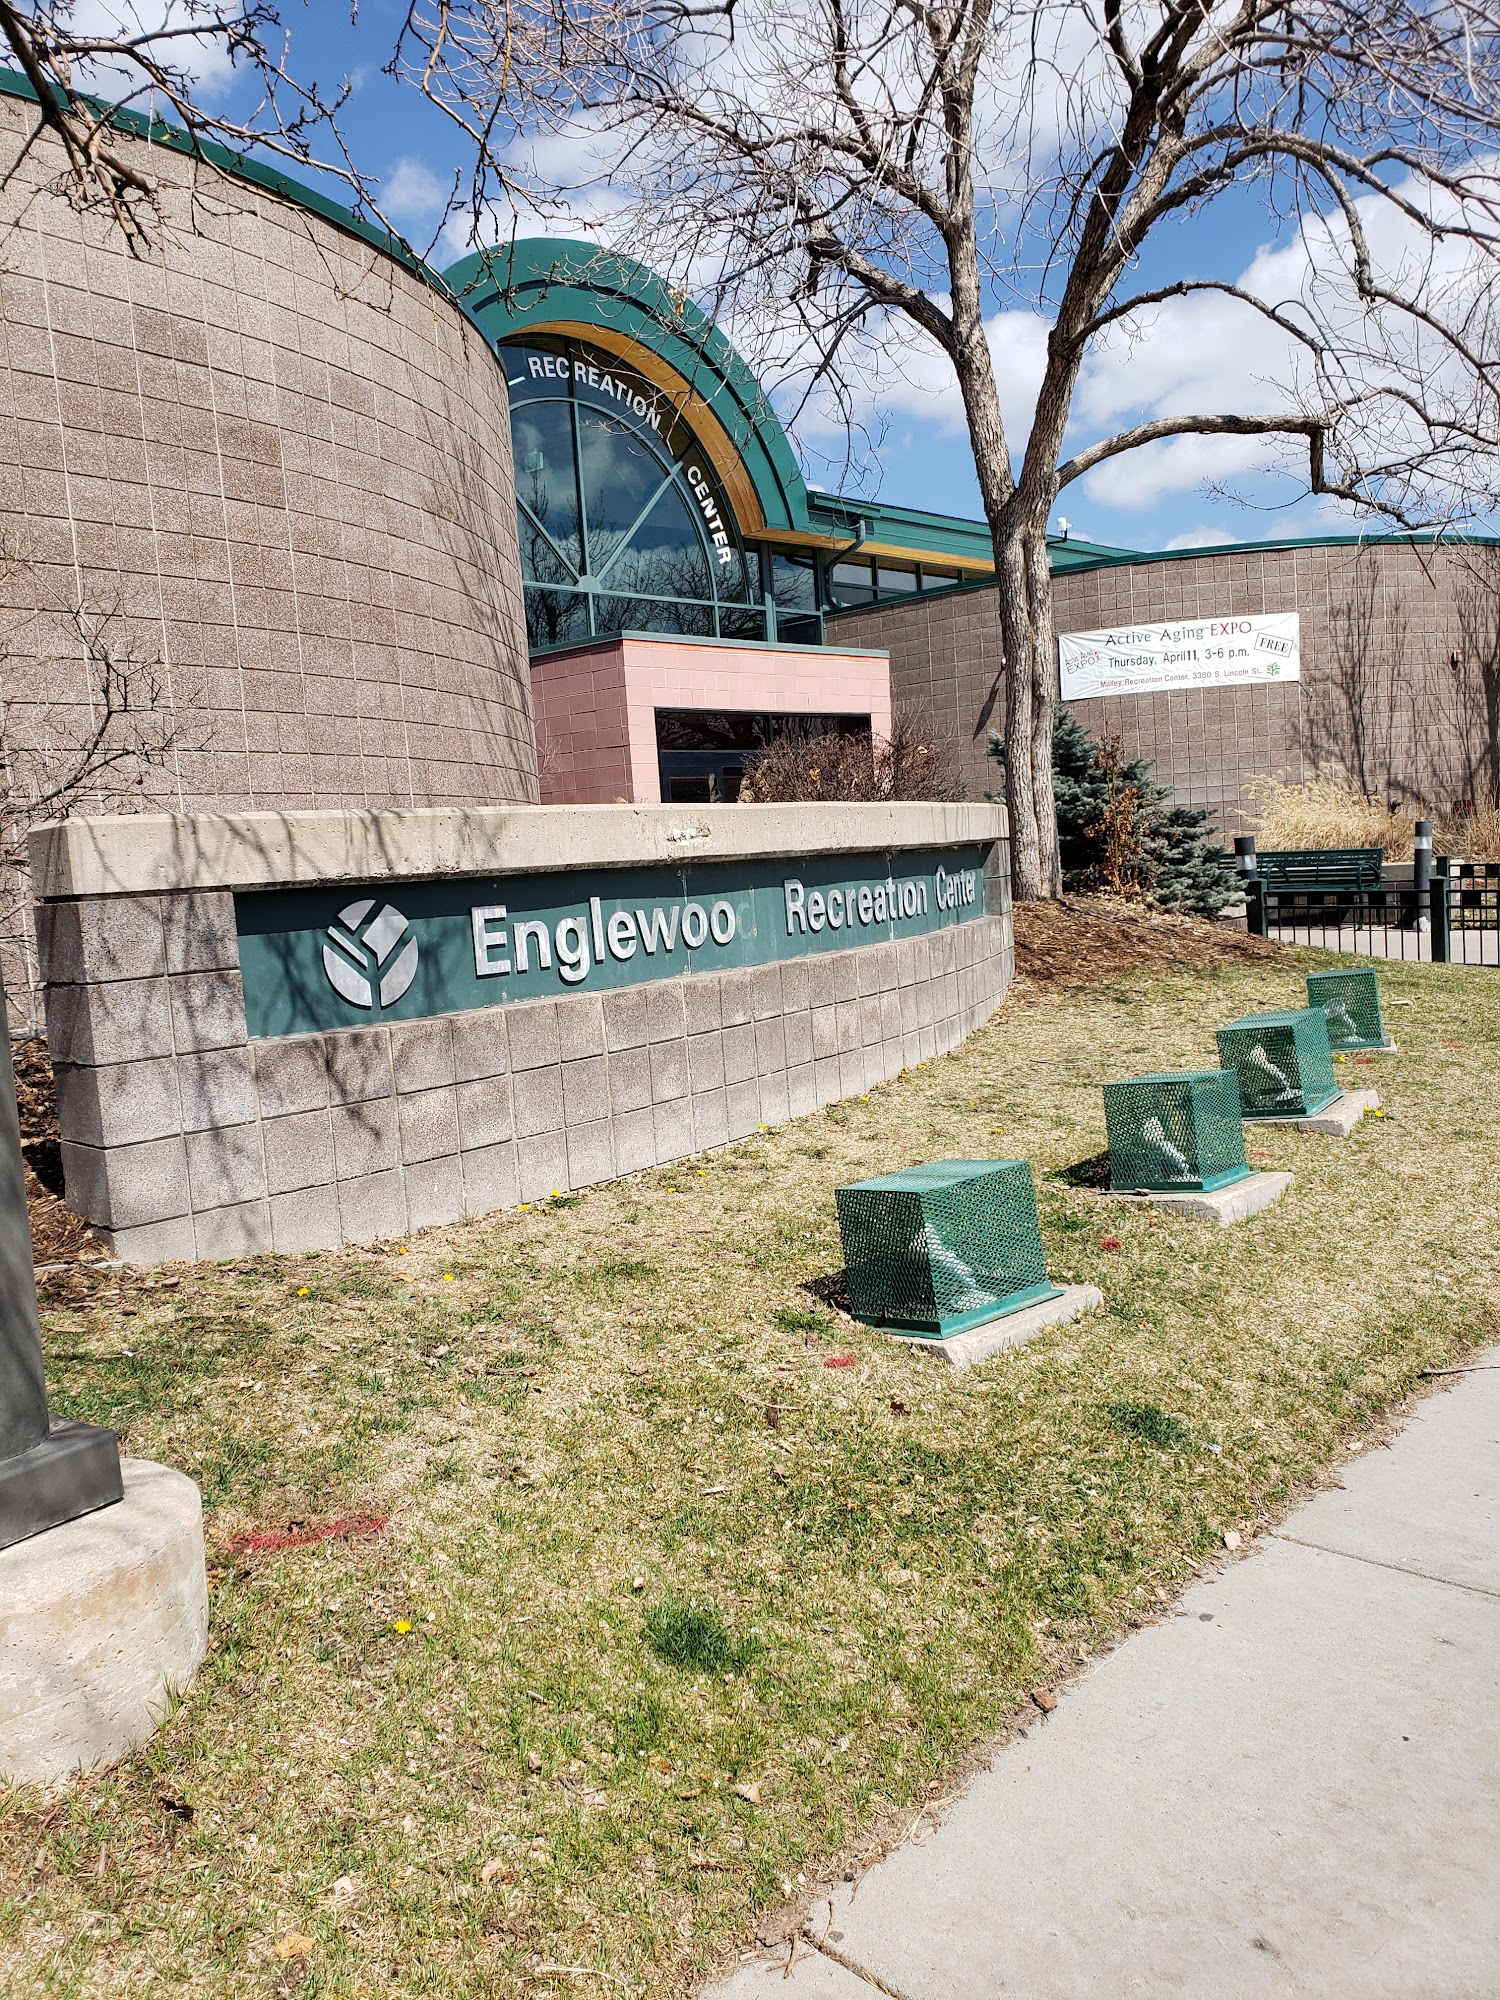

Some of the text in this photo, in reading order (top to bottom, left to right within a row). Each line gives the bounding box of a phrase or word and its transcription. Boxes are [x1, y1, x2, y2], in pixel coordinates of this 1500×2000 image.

[527, 356, 732, 565] RECREATION CENTER
[1105, 621, 1252, 646] Active Aging EXPO
[1259, 637, 1289, 653] FREE
[1067, 656, 1095, 675] EXPO
[1108, 655, 1157, 668] Thursday,
[1205, 647, 1224, 660] 3-6
[1228, 648, 1250, 659] p.m.
[1124, 676, 1162, 686] Recreation
[1192, 671, 1211, 680] 3380
[1214, 670, 1222, 678] S.
[1223, 669, 1249, 677] Lincoln
[1251, 667, 1262, 675] St.
[784, 876, 927, 934] Recreation
[935, 865, 976, 910] Center
